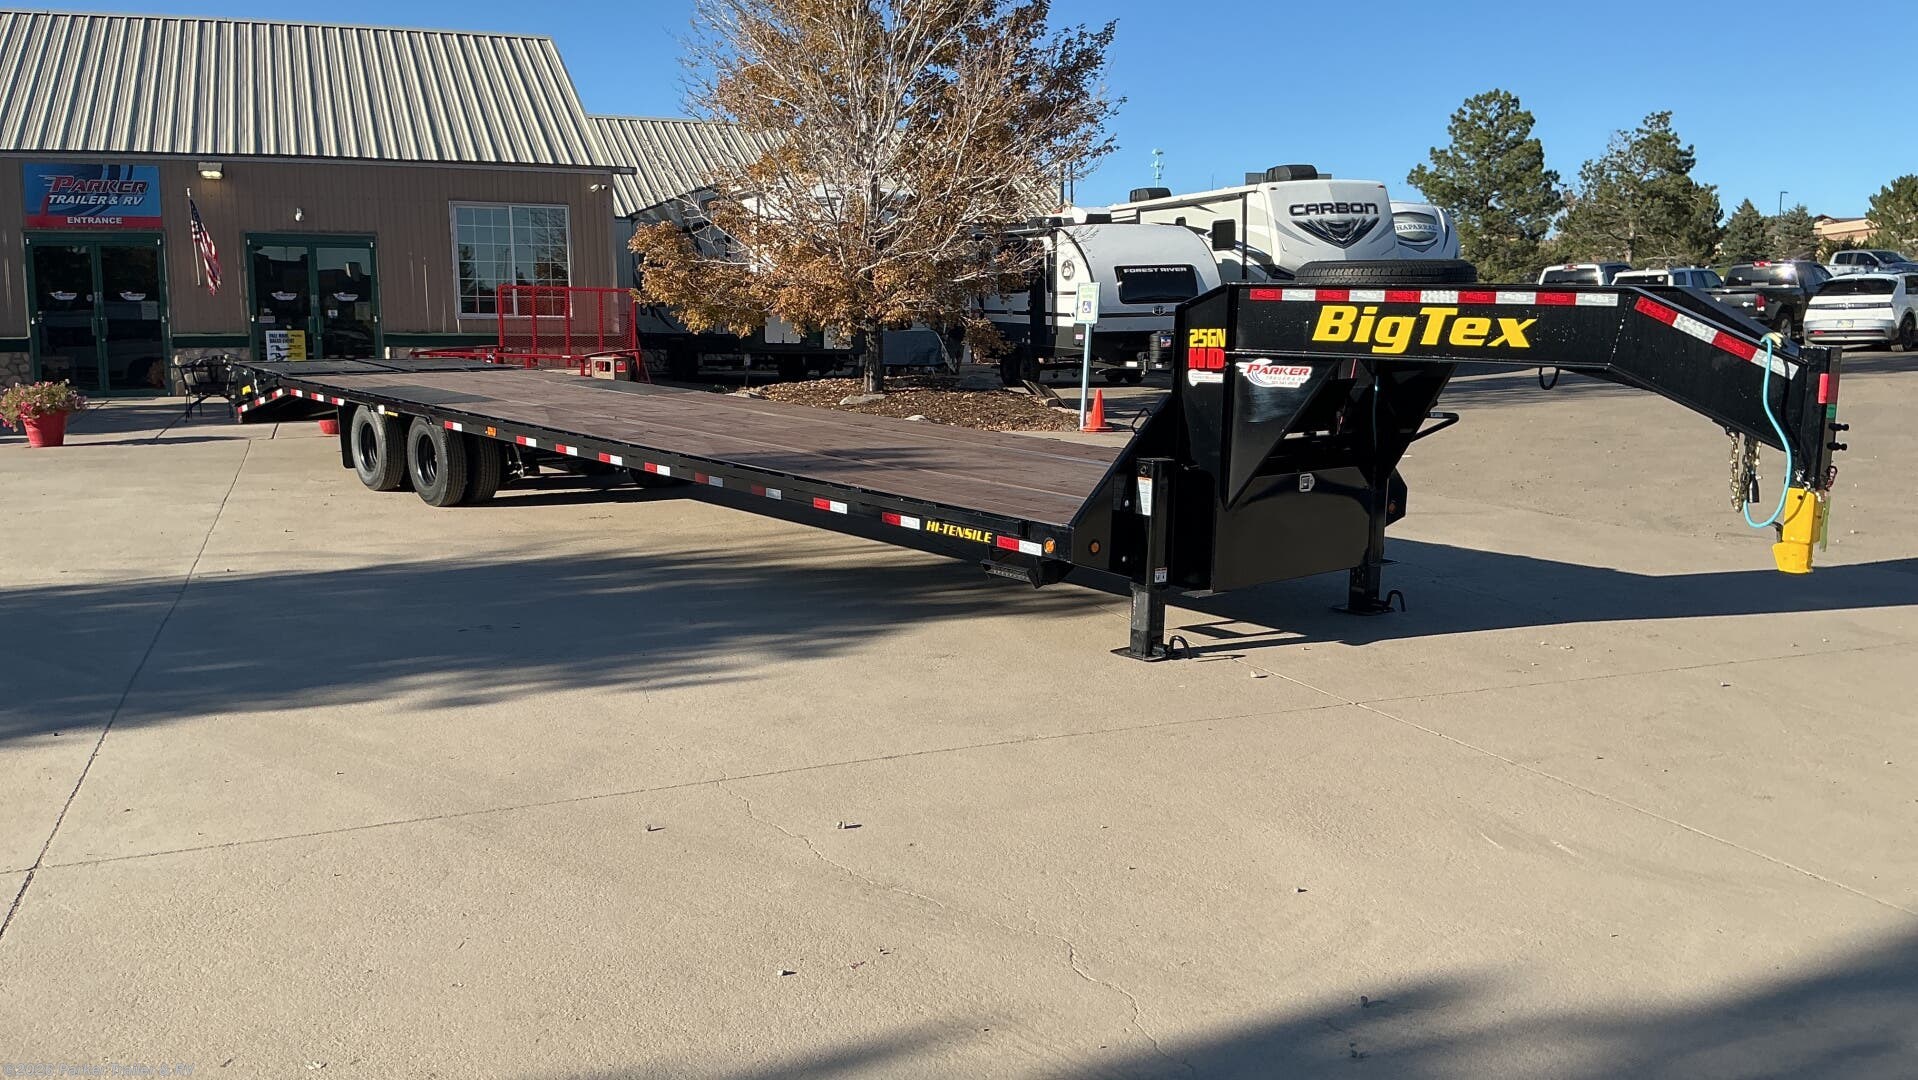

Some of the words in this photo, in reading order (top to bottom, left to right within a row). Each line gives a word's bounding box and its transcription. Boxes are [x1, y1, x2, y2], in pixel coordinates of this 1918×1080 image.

[50, 175, 148, 194] PARKER
[49, 195, 107, 205] TRAILER
[108, 196, 118, 205] &
[123, 196, 143, 205] RV
[1289, 202, 1379, 216] CARBON
[67, 216, 123, 225] ENTRANCE
[1396, 223, 1437, 232] HAPARRAL
[1312, 305, 1537, 354] BigTex
[1189, 348, 1225, 369] HD
[1247, 364, 1310, 376] PARKER
[926, 520, 993, 544] HI-TENSILE
